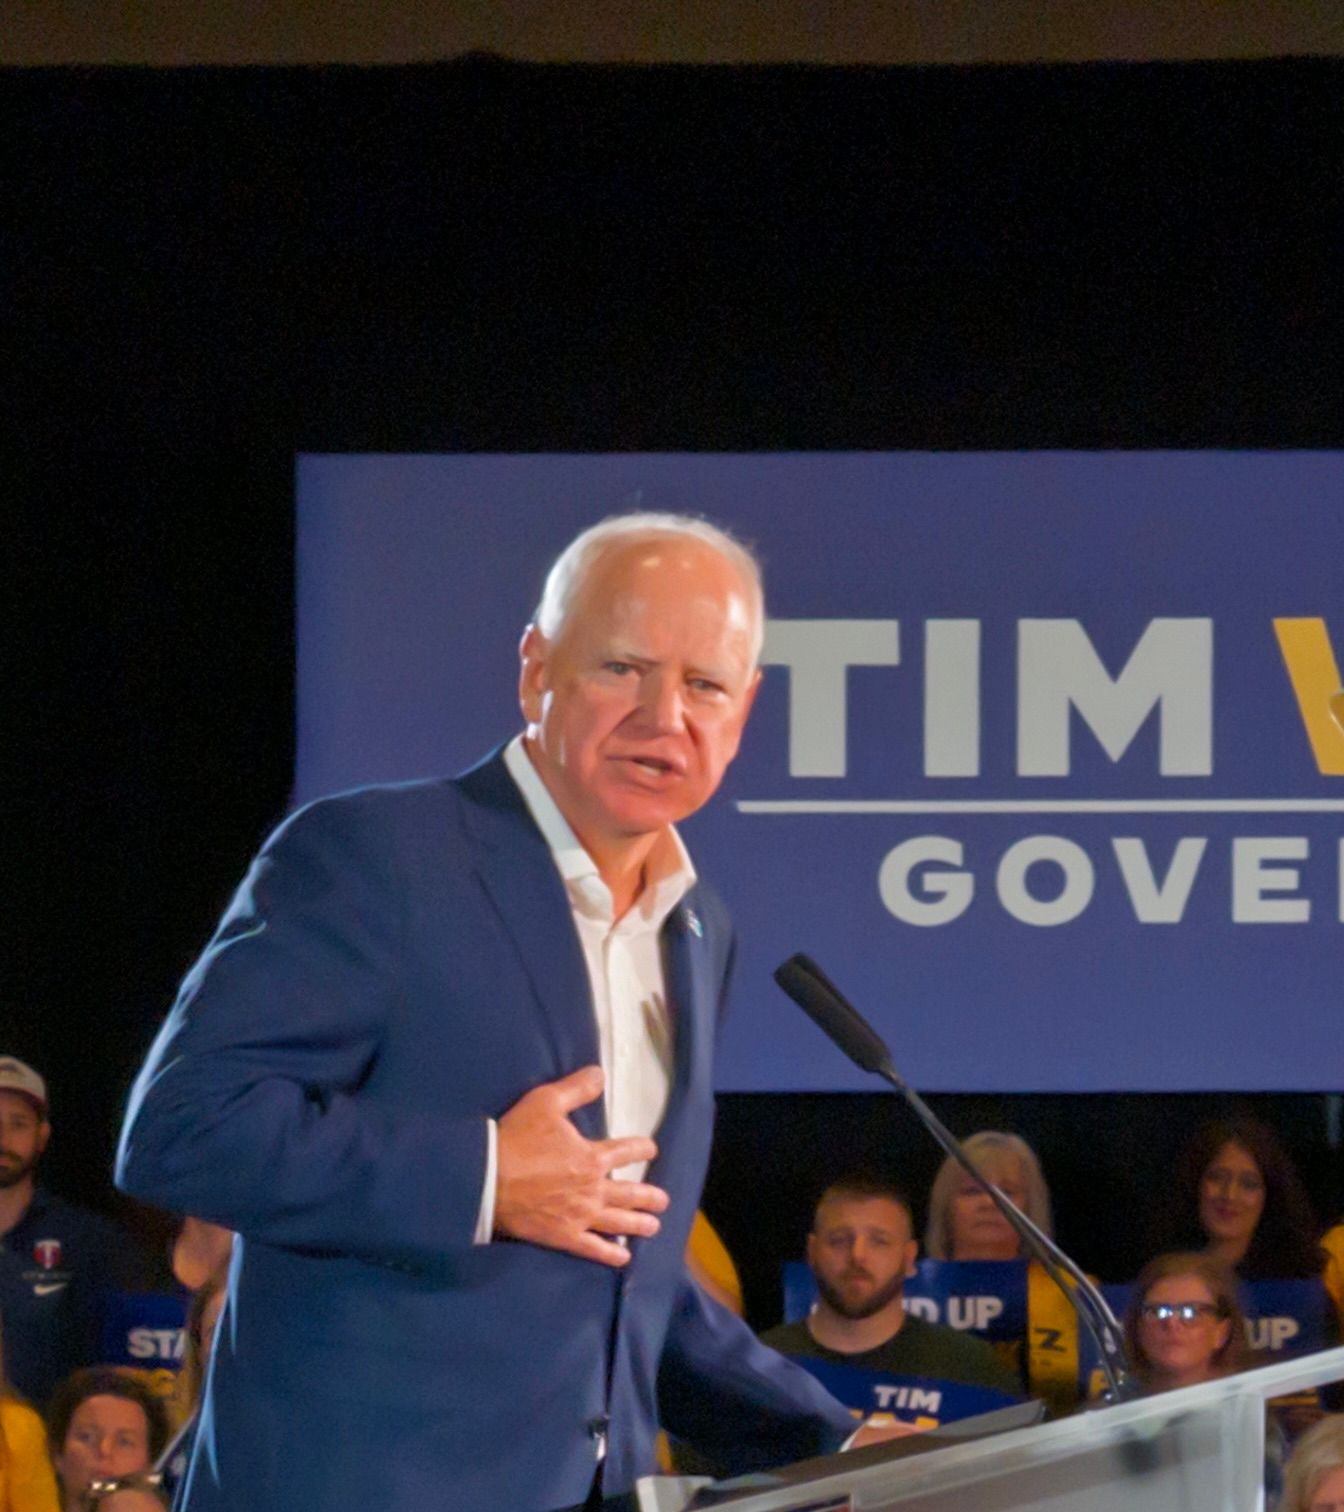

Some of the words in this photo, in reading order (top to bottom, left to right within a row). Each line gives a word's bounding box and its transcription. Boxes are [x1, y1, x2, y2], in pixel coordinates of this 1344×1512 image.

[756, 616, 1213, 778] TIM
[947, 1296, 1003, 1330] UP
[873, 1385, 942, 1413] TIM
